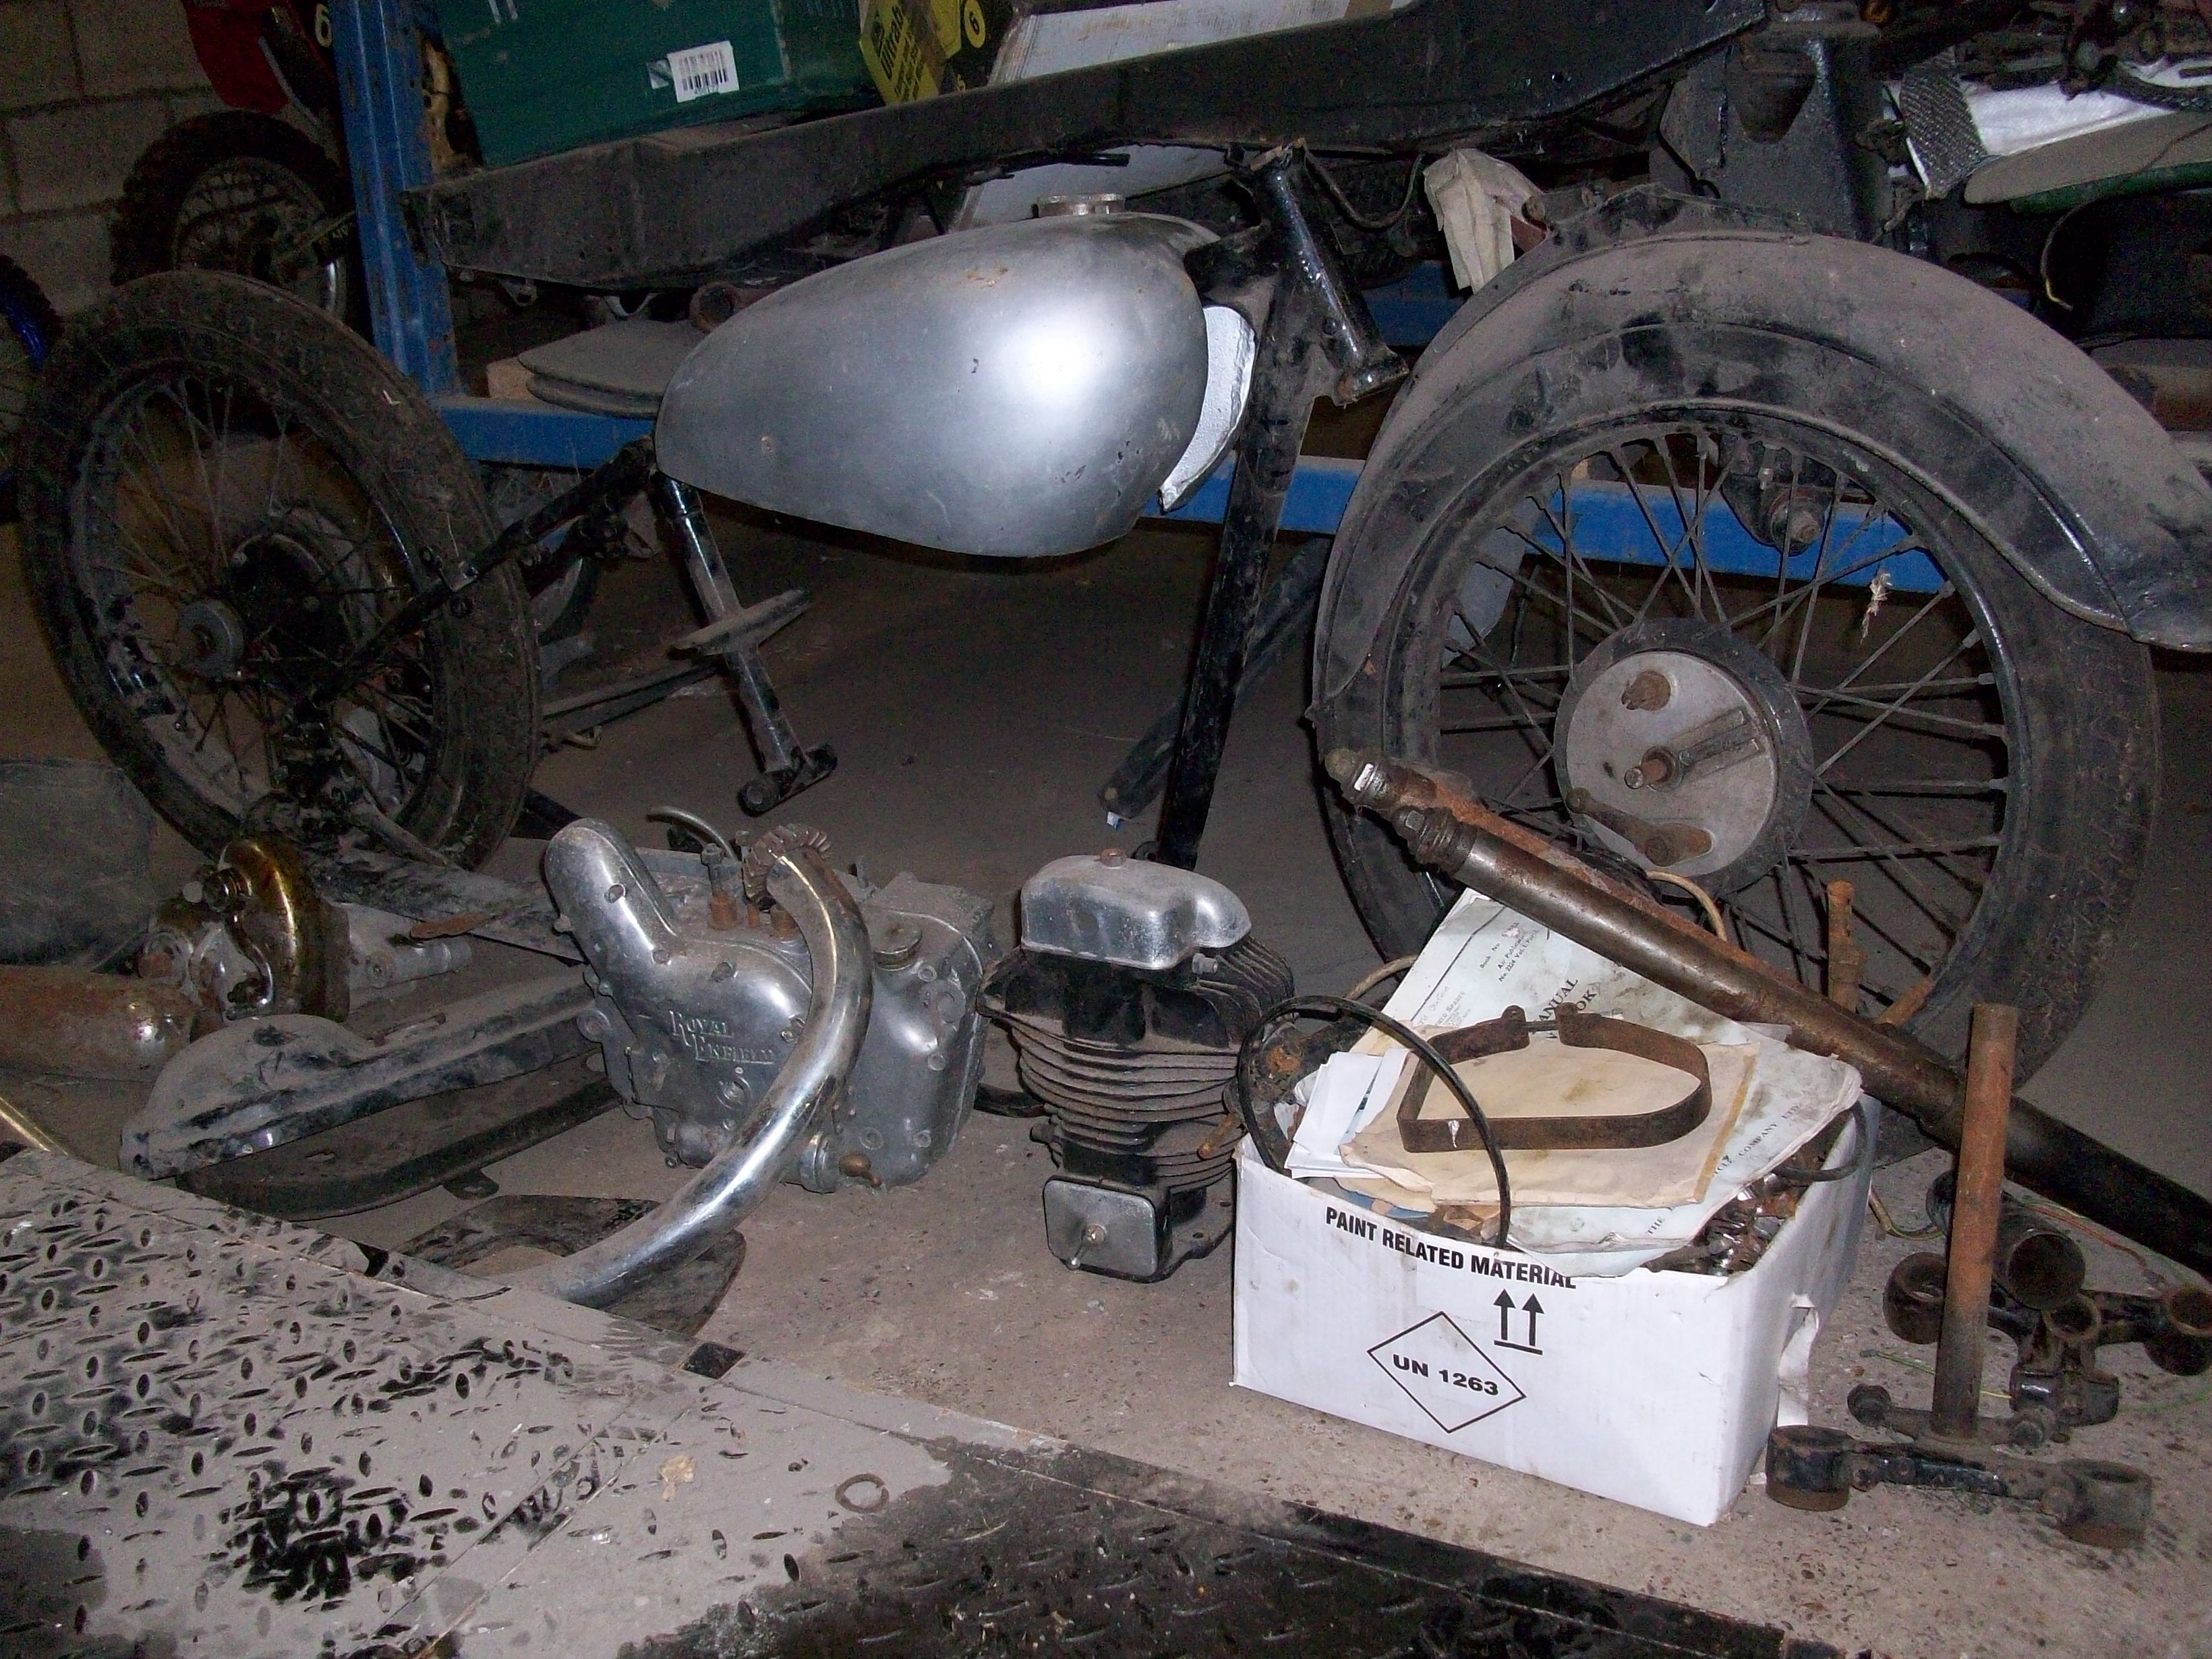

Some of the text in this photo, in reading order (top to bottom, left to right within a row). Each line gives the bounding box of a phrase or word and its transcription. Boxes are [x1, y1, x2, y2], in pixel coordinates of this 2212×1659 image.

[1436, 1013, 1447, 1026] IELD
[1536, 979, 1578, 1024] ANUAL
[1738, 1122, 1778, 1156] COMPANY
[1646, 1216, 1665, 1235] THE
[1325, 1206, 1577, 1289] PAINT RELATED MATERIAL
[1393, 1354, 1499, 1397] UN 1263
